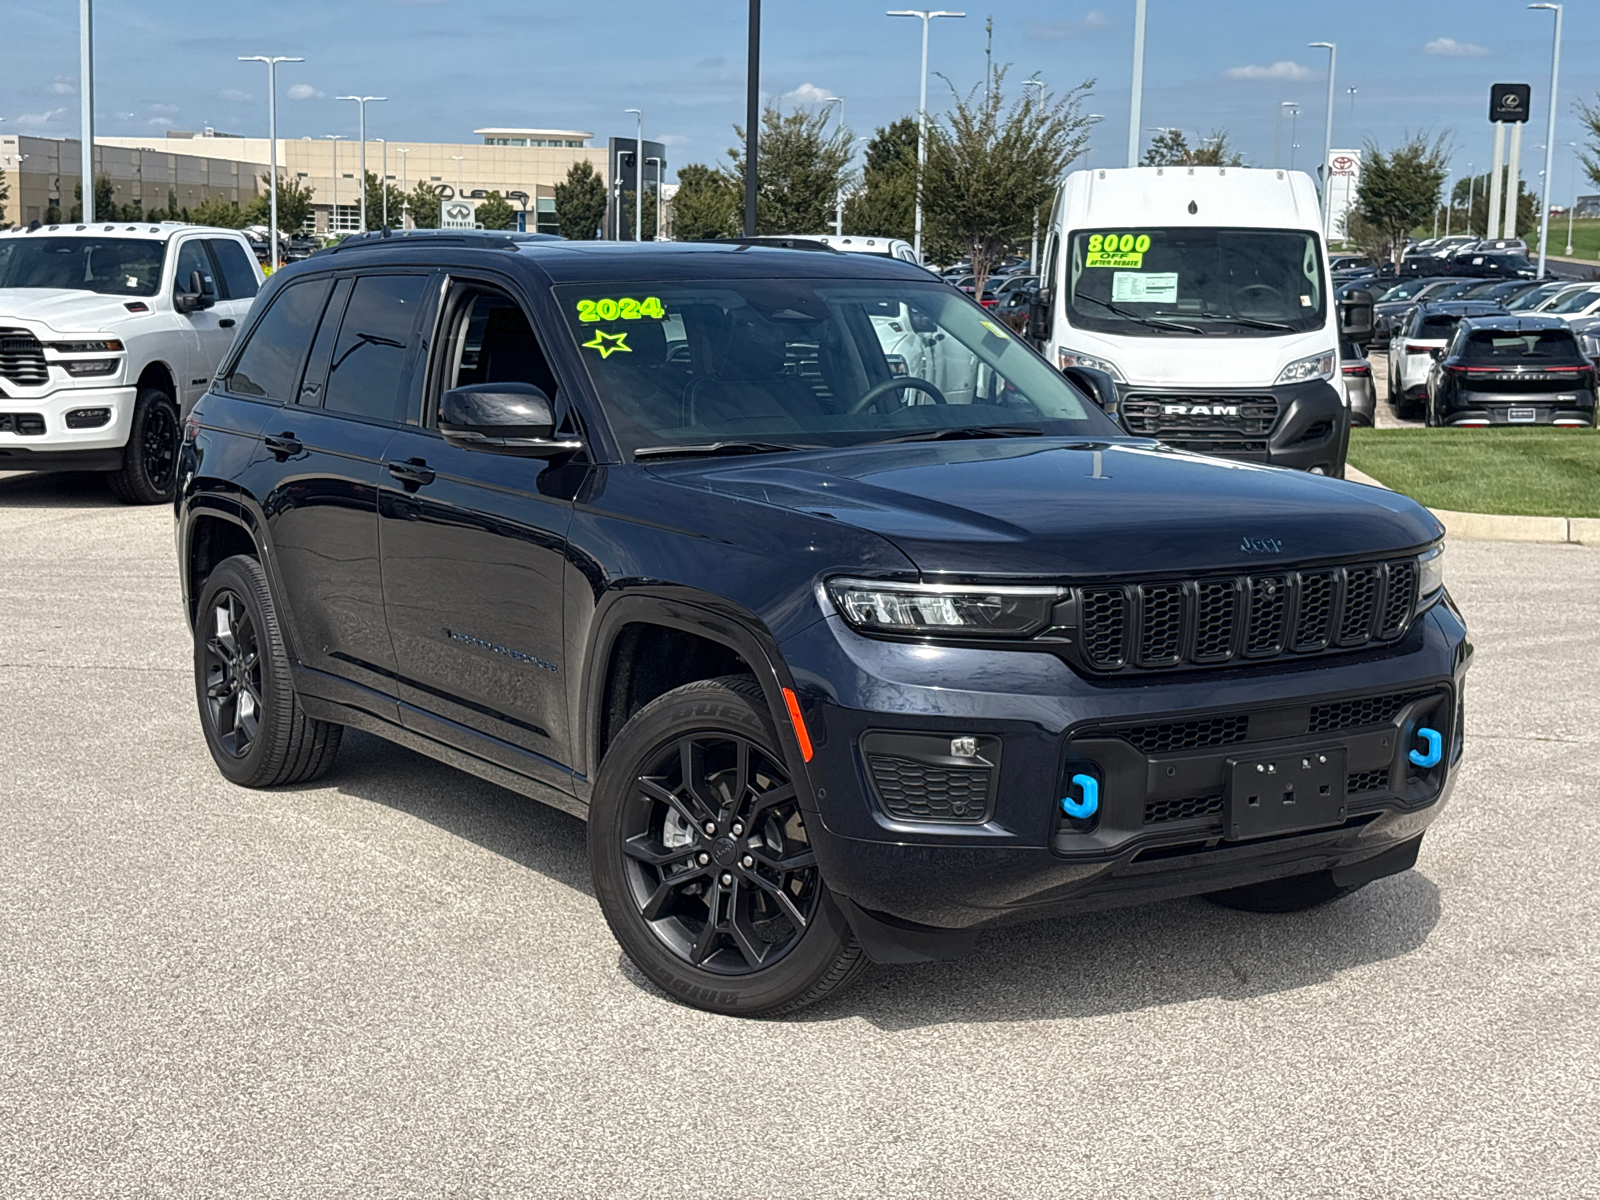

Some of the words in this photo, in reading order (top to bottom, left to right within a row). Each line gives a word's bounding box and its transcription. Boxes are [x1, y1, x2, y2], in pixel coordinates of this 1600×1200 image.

[443, 220, 475, 228] INFINITI
[1088, 234, 1151, 253] 8000
[1099, 252, 1130, 260] OFF
[576, 297, 666, 322] 2024
[192, 378, 208, 386] RAM
[1164, 405, 1238, 416] RAM
[1240, 536, 1282, 554] Jeep
